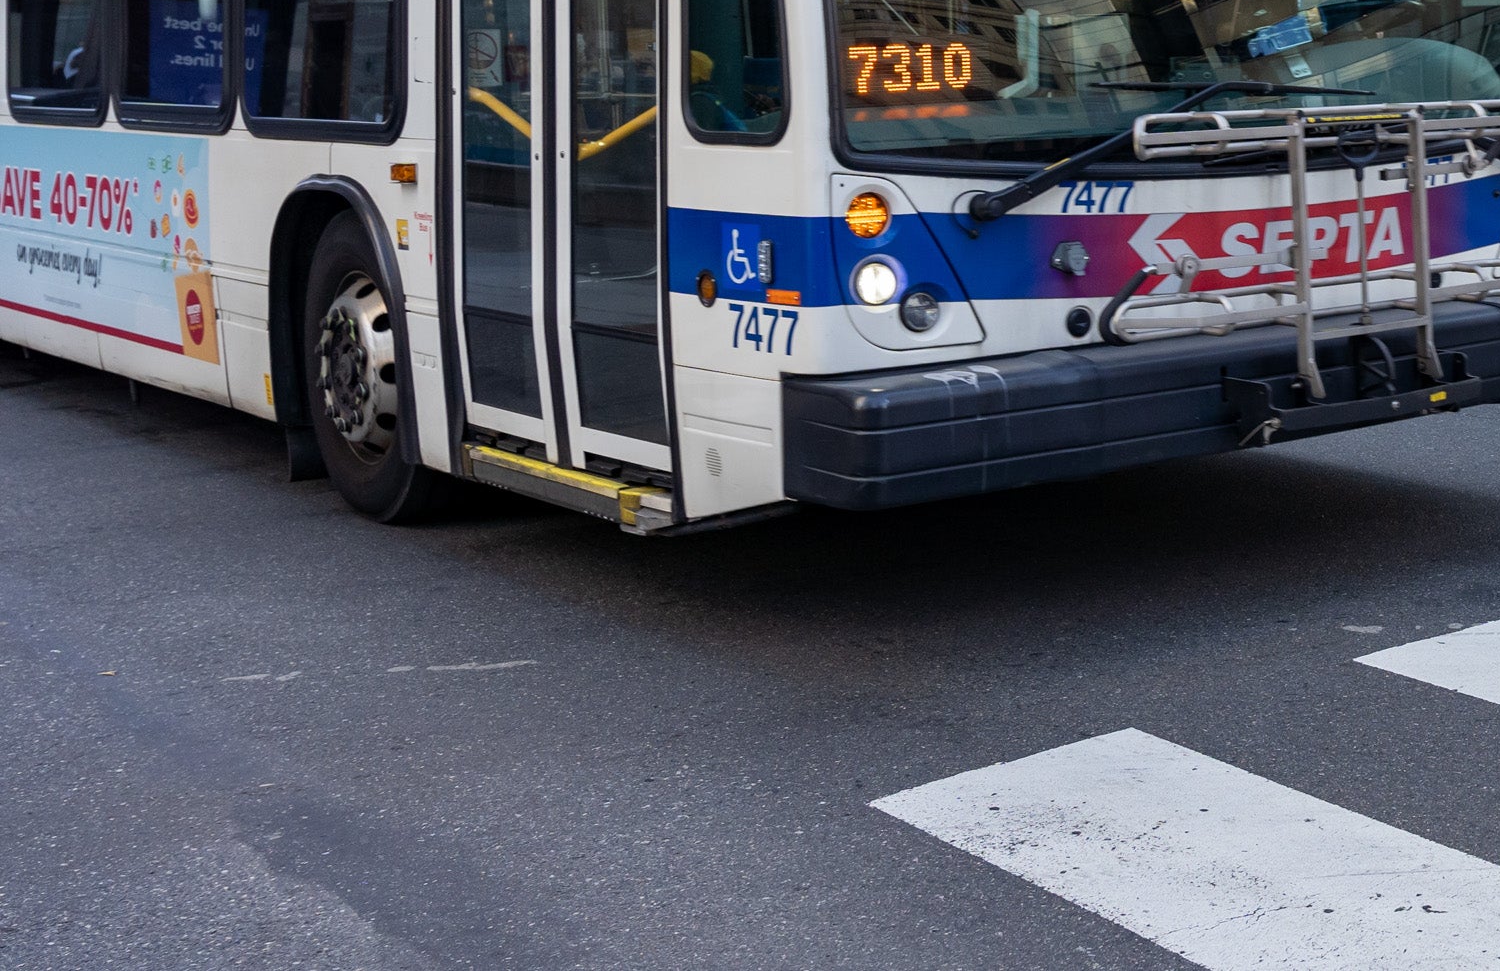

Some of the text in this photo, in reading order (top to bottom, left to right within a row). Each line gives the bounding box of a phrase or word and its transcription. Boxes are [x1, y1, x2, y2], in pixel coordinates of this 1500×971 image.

[848, 42, 971, 94] 7310
[0, 166, 42, 220] AVE
[1058, 181, 1134, 214] 7477
[1221, 206, 1405, 278] SEPTA
[729, 303, 799, 356] 7477
